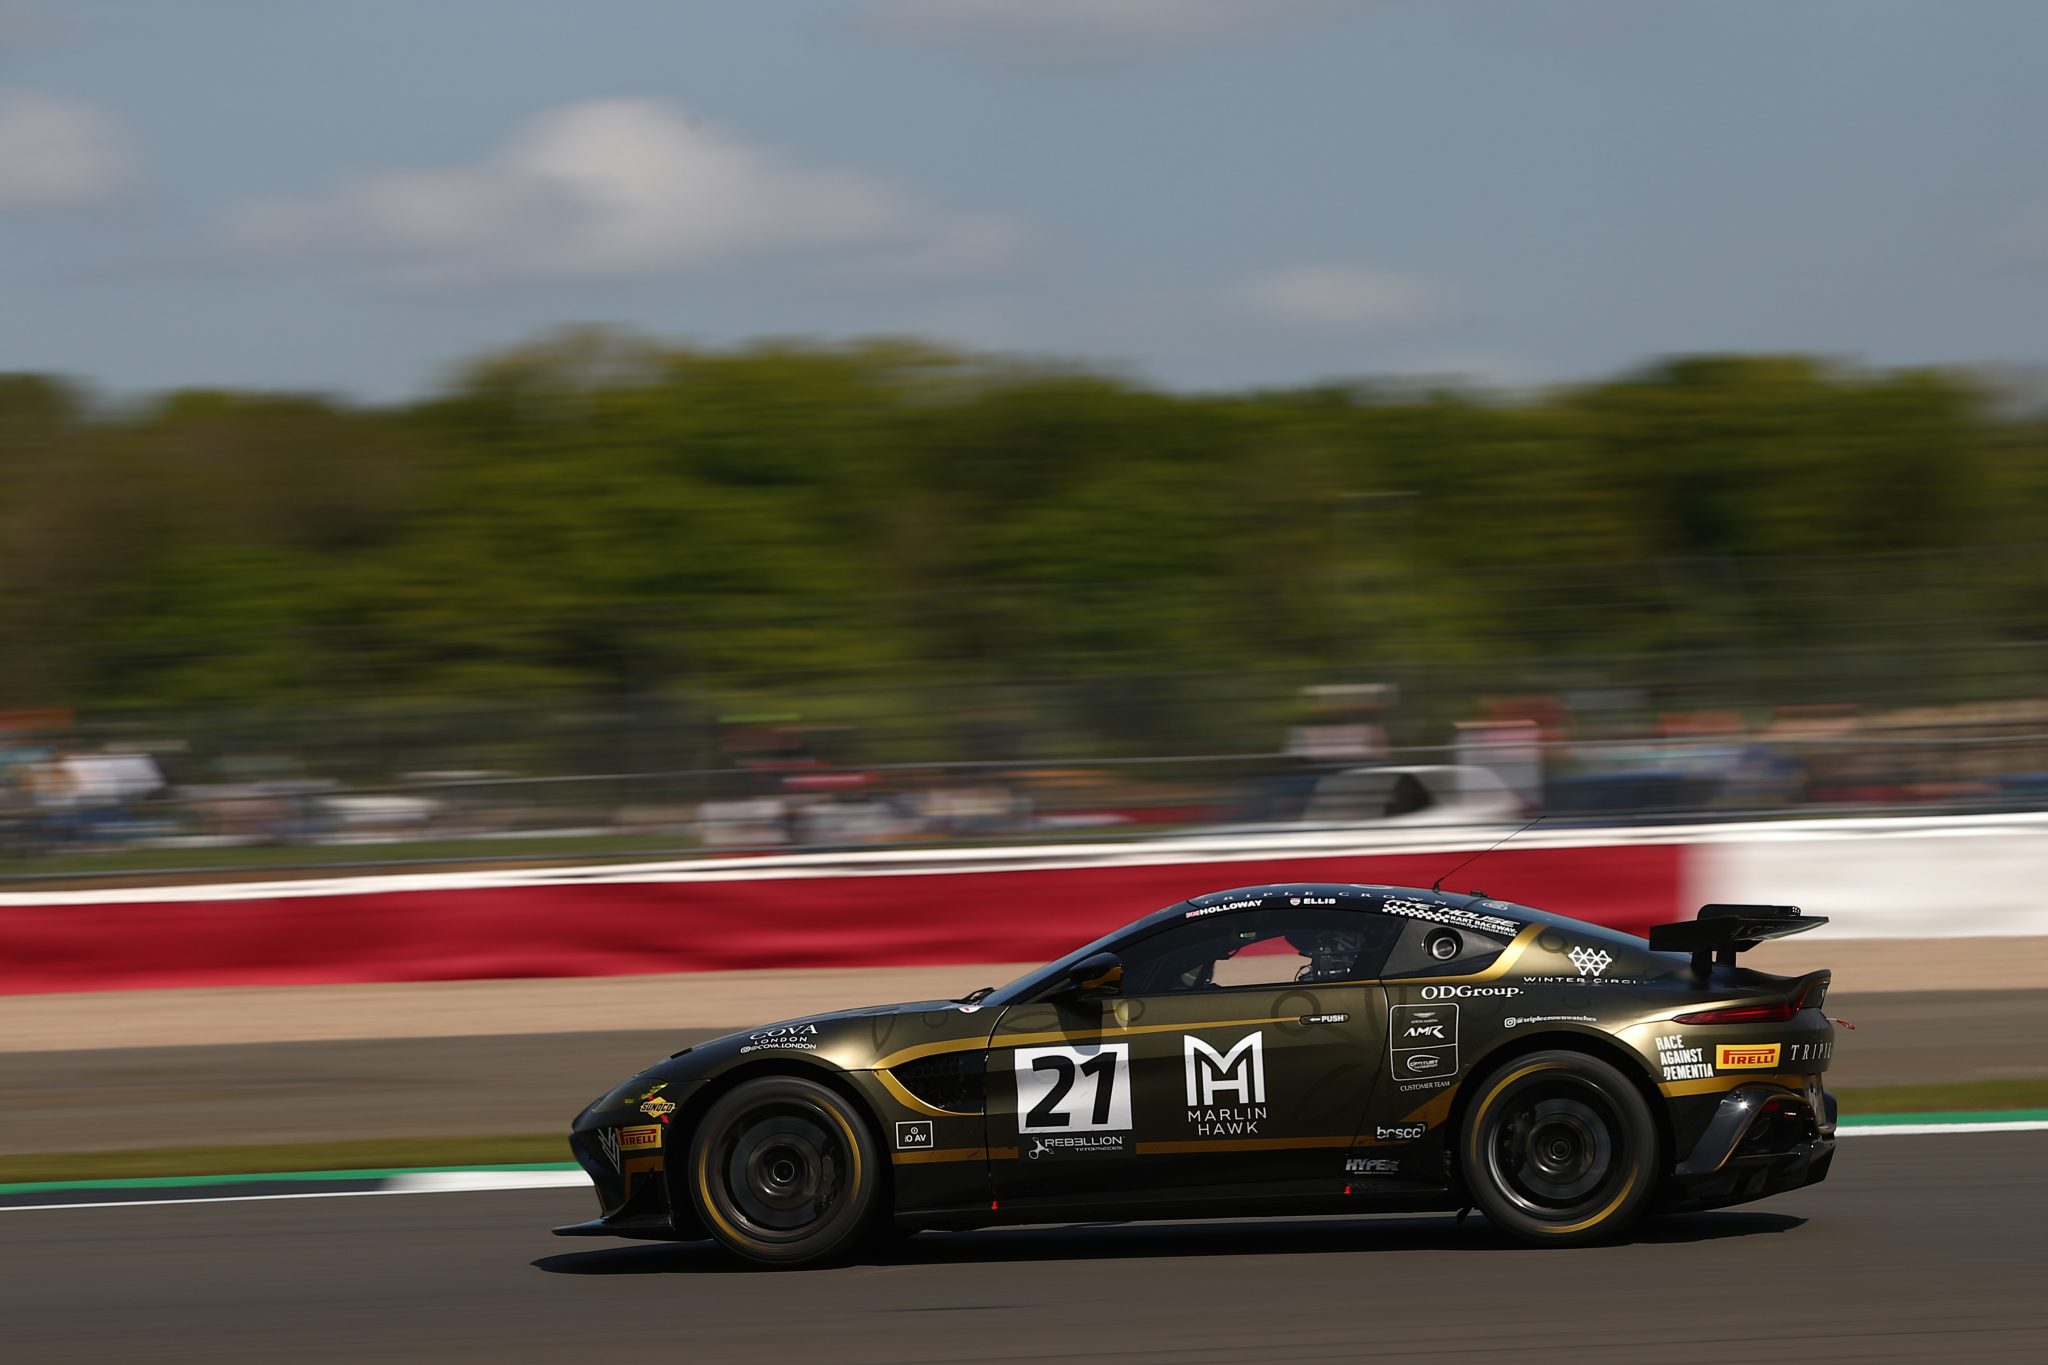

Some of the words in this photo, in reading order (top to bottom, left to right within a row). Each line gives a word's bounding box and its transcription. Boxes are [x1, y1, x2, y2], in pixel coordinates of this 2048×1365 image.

[1339, 892, 1447, 905] CROWN
[1199, 899, 1263, 915] HOLLOWAY
[1438, 907, 1520, 927] HOUSE
[1450, 915, 1473, 924] KART
[1420, 984, 1525, 1000] ODGroup.
[1321, 1014, 1344, 1023] PUSH
[1516, 1015, 1597, 1024] @triplecrownwatches
[750, 1024, 818, 1040] COVA
[1403, 1025, 1445, 1039] AMR
[755, 1036, 807, 1045] LONDON
[1655, 1035, 1684, 1051] RACE
[1659, 1048, 1703, 1066] AGAINST
[1722, 1048, 1776, 1065] PIRELLI
[1664, 1063, 1714, 1081] DEMENTIA
[1025, 1052, 1118, 1128] 21
[1400, 1082, 1433, 1092] CUSTOMER
[1434, 1080, 1450, 1088] TEAM
[641, 1102, 674, 1112] SUNOCO
[1188, 1107, 1267, 1123] MARLIN
[1198, 1121, 1258, 1136] HAWK
[1376, 1126, 1423, 1139] brscc
[620, 1128, 657, 1146] PIRELLI
[914, 1133, 927, 1142] AV
[1045, 1136, 1123, 1147] REBELLION
